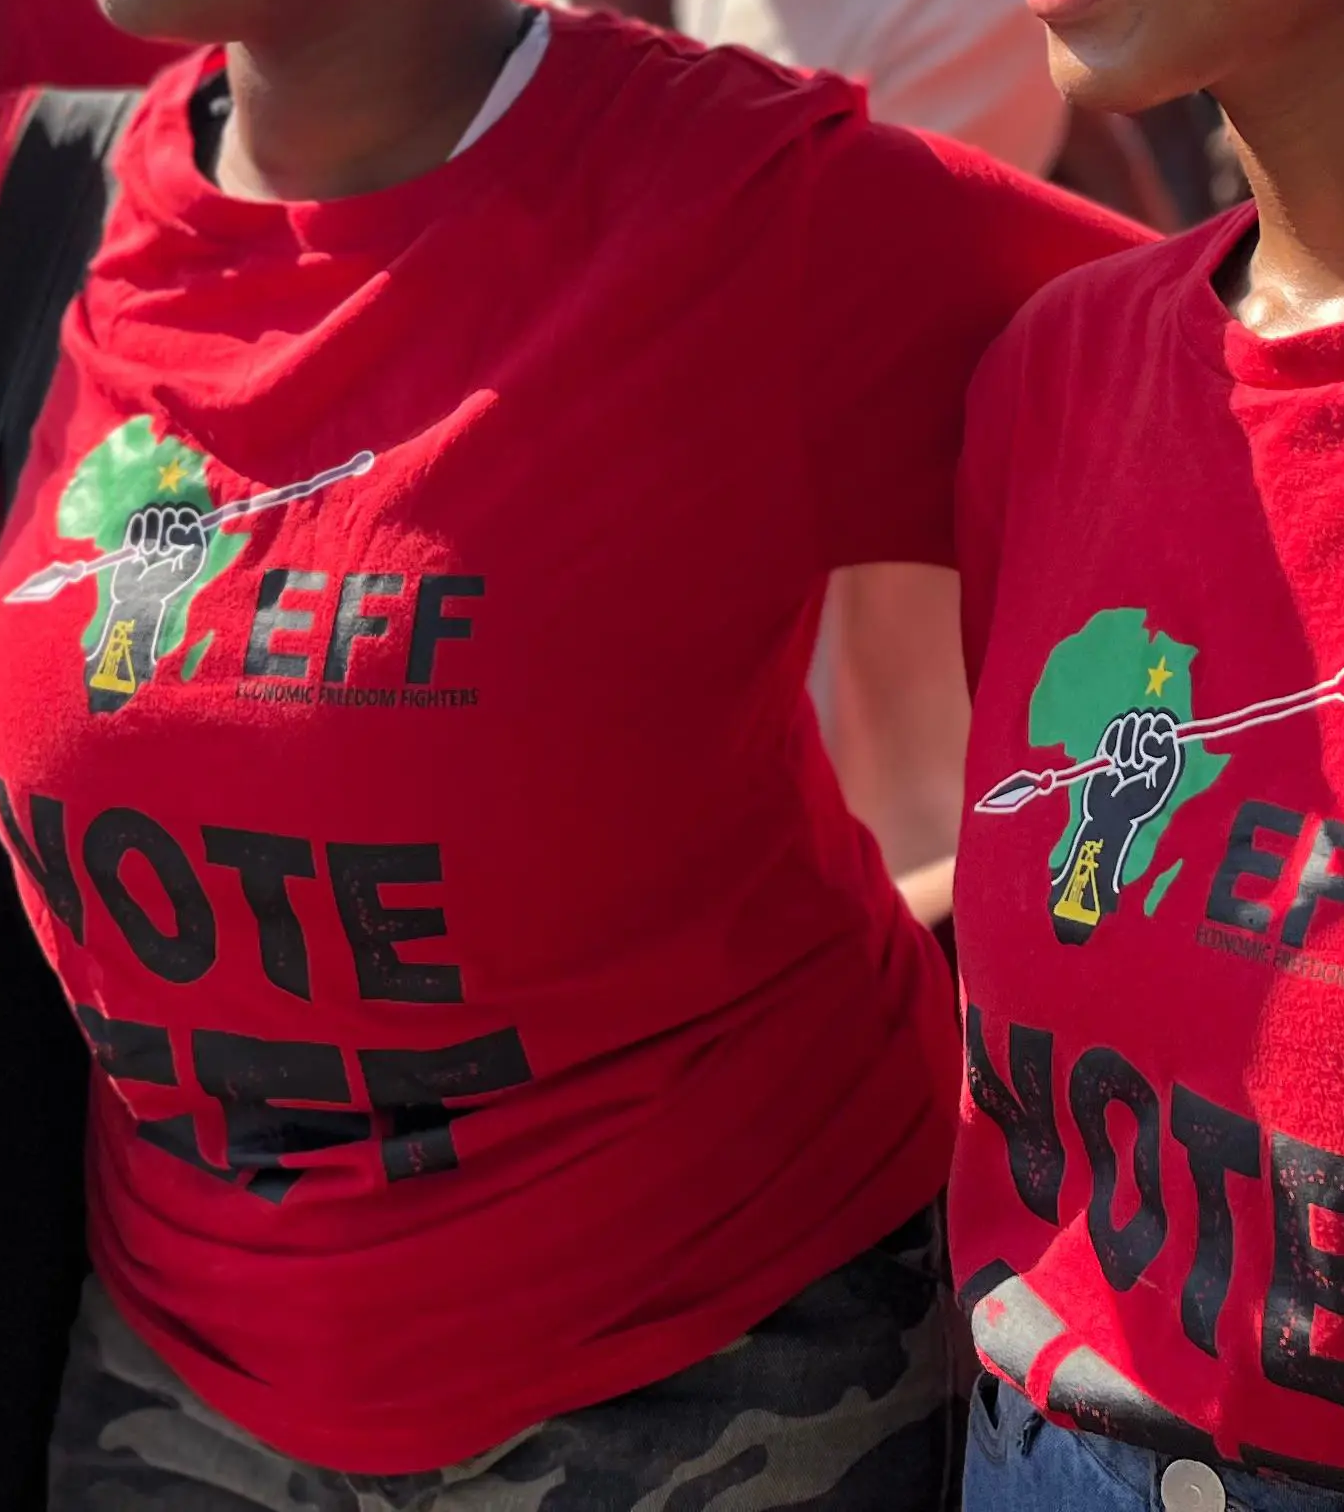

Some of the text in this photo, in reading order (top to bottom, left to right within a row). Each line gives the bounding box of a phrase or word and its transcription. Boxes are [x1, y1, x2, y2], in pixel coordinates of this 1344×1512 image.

[243, 569, 485, 686] EFF
[236, 681, 479, 708] ECONOMIC FREEDOM FIGHTERS
